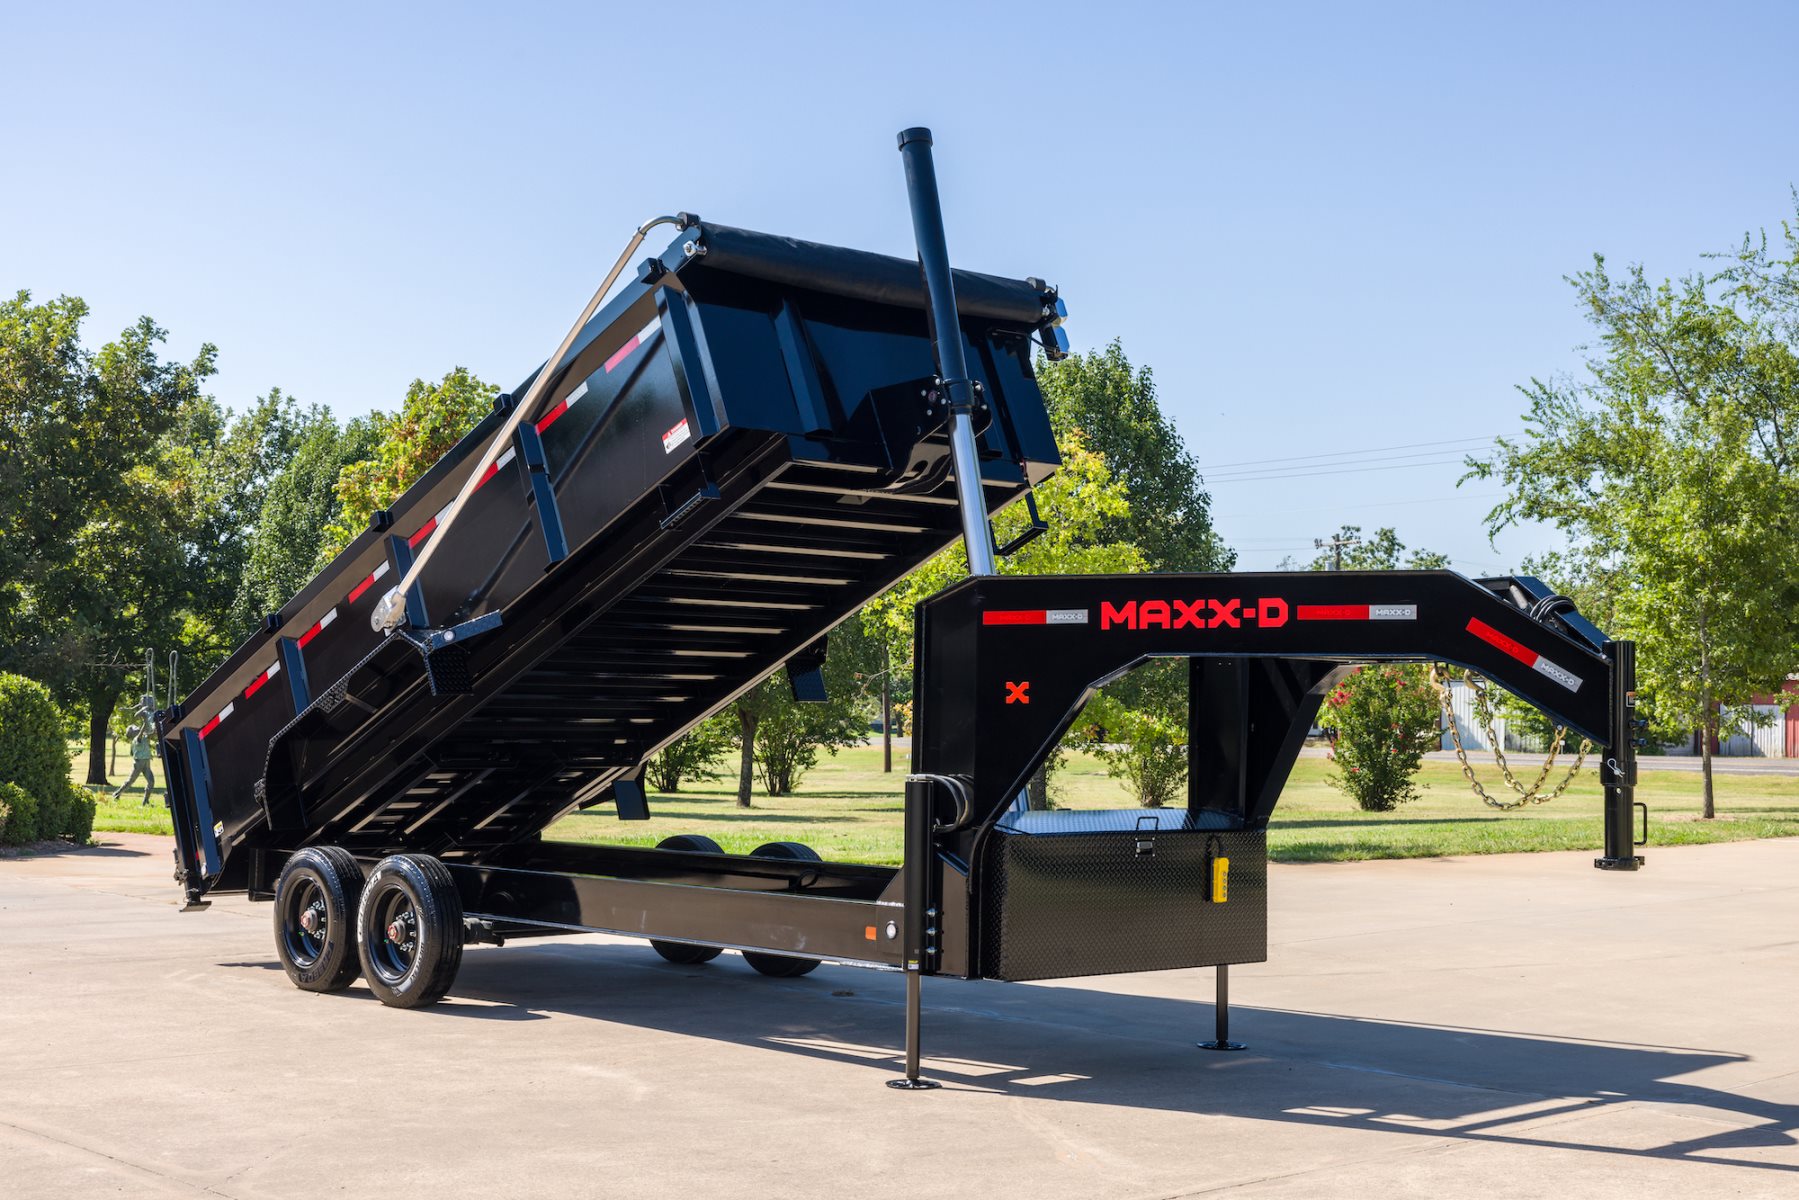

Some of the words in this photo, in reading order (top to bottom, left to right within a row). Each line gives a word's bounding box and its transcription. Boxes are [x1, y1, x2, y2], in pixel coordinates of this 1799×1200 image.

[1052, 613, 1083, 621] MAXX-D
[1101, 598, 1289, 630] MAXX-D
[1375, 608, 1411, 616] MAXX-D
[1540, 662, 1575, 686] MAXX-D
